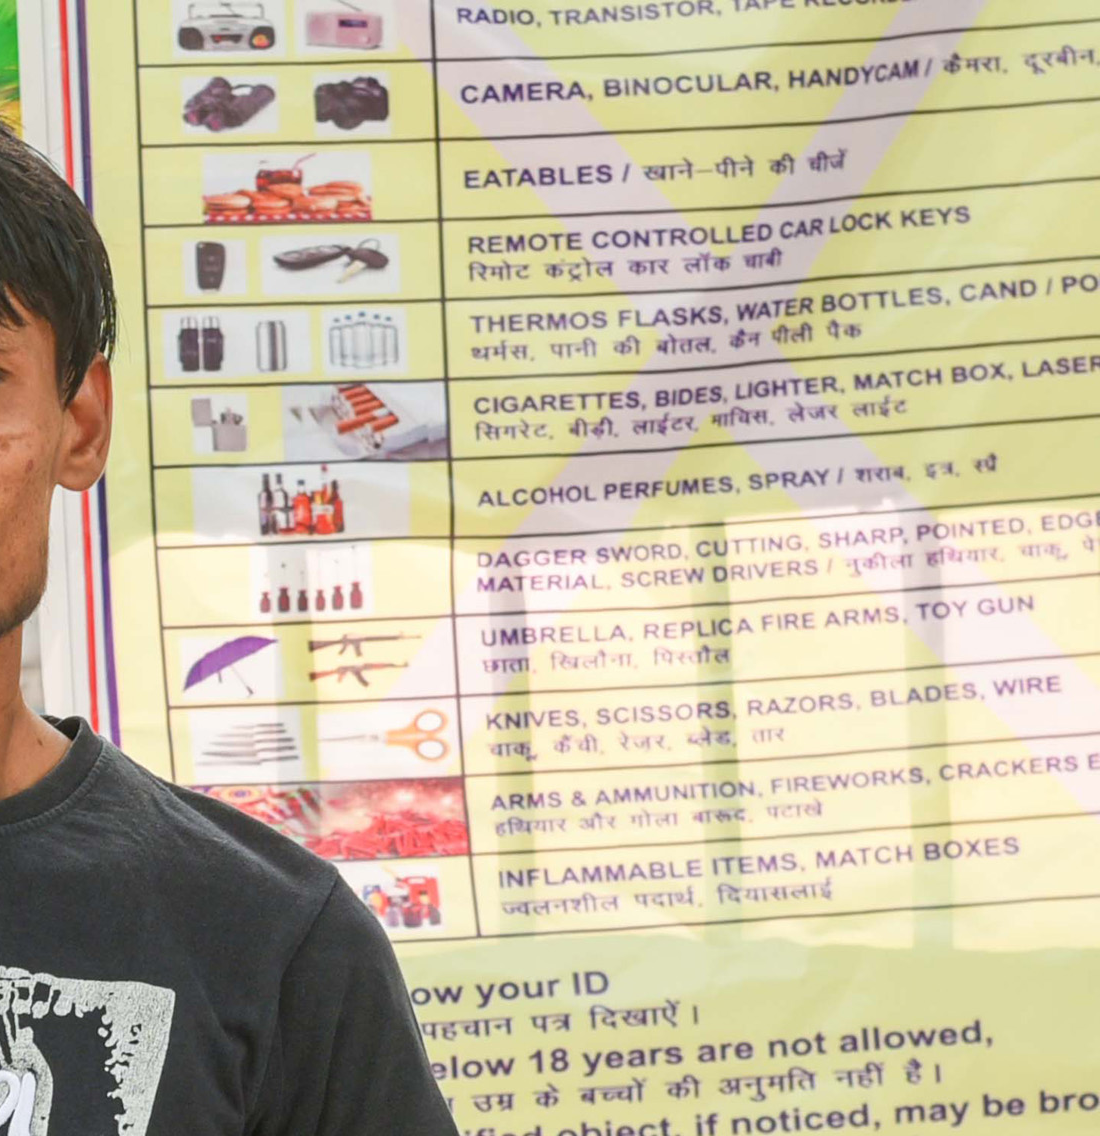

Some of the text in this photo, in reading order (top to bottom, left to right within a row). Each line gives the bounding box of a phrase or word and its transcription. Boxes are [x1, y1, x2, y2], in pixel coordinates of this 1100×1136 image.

[457, 7, 542, 27] RADIO,
[551, 1, 722, 26] TRANSISTOR,
[461, 81, 594, 104] CAMERA,
[603, 71, 779, 97] BINOCULAR,
[789, 59, 919, 89] HANDYCAM
[464, 164, 613, 189] EATABLES
[769, 152, 796, 176] की
[468, 206, 971, 254] REMOTE CONTROLLED CAR LOCK KEYS
[468, 261, 530, 282] रिमोट
[628, 257, 669, 276] कार
[683, 252, 732, 274] लॉक
[470, 310, 608, 334] THERMOS
[617, 305, 729, 328] FLASKS,
[736, 296, 814, 321] WATER
[821, 286, 952, 313] BOTTLES,
[959, 279, 1037, 302] CAND
[549, 338, 598, 359] पानी
[612, 335, 641, 356] की
[473, 354, 1100, 415] CIGARETTES, BIDES, LIGHTER, MATCH BOX, LASER
[477, 486, 596, 508] ALCOHOL
[603, 475, 741, 501] PERFUMES,
[748, 468, 831, 491] SPRAY
[476, 549, 586, 568] DAGGER
[595, 543, 689, 565] SWORD,
[695, 533, 810, 559] CUTTING,
[818, 526, 909, 550] SHARP,
[916, 517, 1033, 542] POINTED,
[476, 573, 611, 593] MATERIAL,
[620, 567, 705, 588] SCREW
[712, 558, 819, 583] DRIVERS
[481, 595, 1035, 647] UMBRELLA, REPLICA FIRE ARMS, TOY GUN
[485, 675, 1062, 732] KNIVES, SCISSORS, RAZORS, BLADES, WIRE
[490, 791, 562, 811] ARMS
[571, 791, 588, 807] &
[594, 780, 764, 805] AMMUNITION,
[770, 766, 932, 795] FIREWORKS,
[939, 754, 1079, 782] CRACKERS
[578, 812, 617, 831] और
[498, 837, 1020, 889] INFLAMMABLE ITEMS, MATCH BOXES
[410, 970, 610, 1010] ow your ID
[421, 1012, 572, 1041] पहचान पत्र
[430, 1018, 994, 1081] elow 18 years are not allowed,
[534, 1082, 561, 1110] के
[665, 1073, 701, 1100] की
[717, 1066, 817, 1103] अनुमति
[730, 1103, 882, 1136] noticed,
[894, 1100, 970, 1128] may
[982, 1093, 1026, 1118] be
